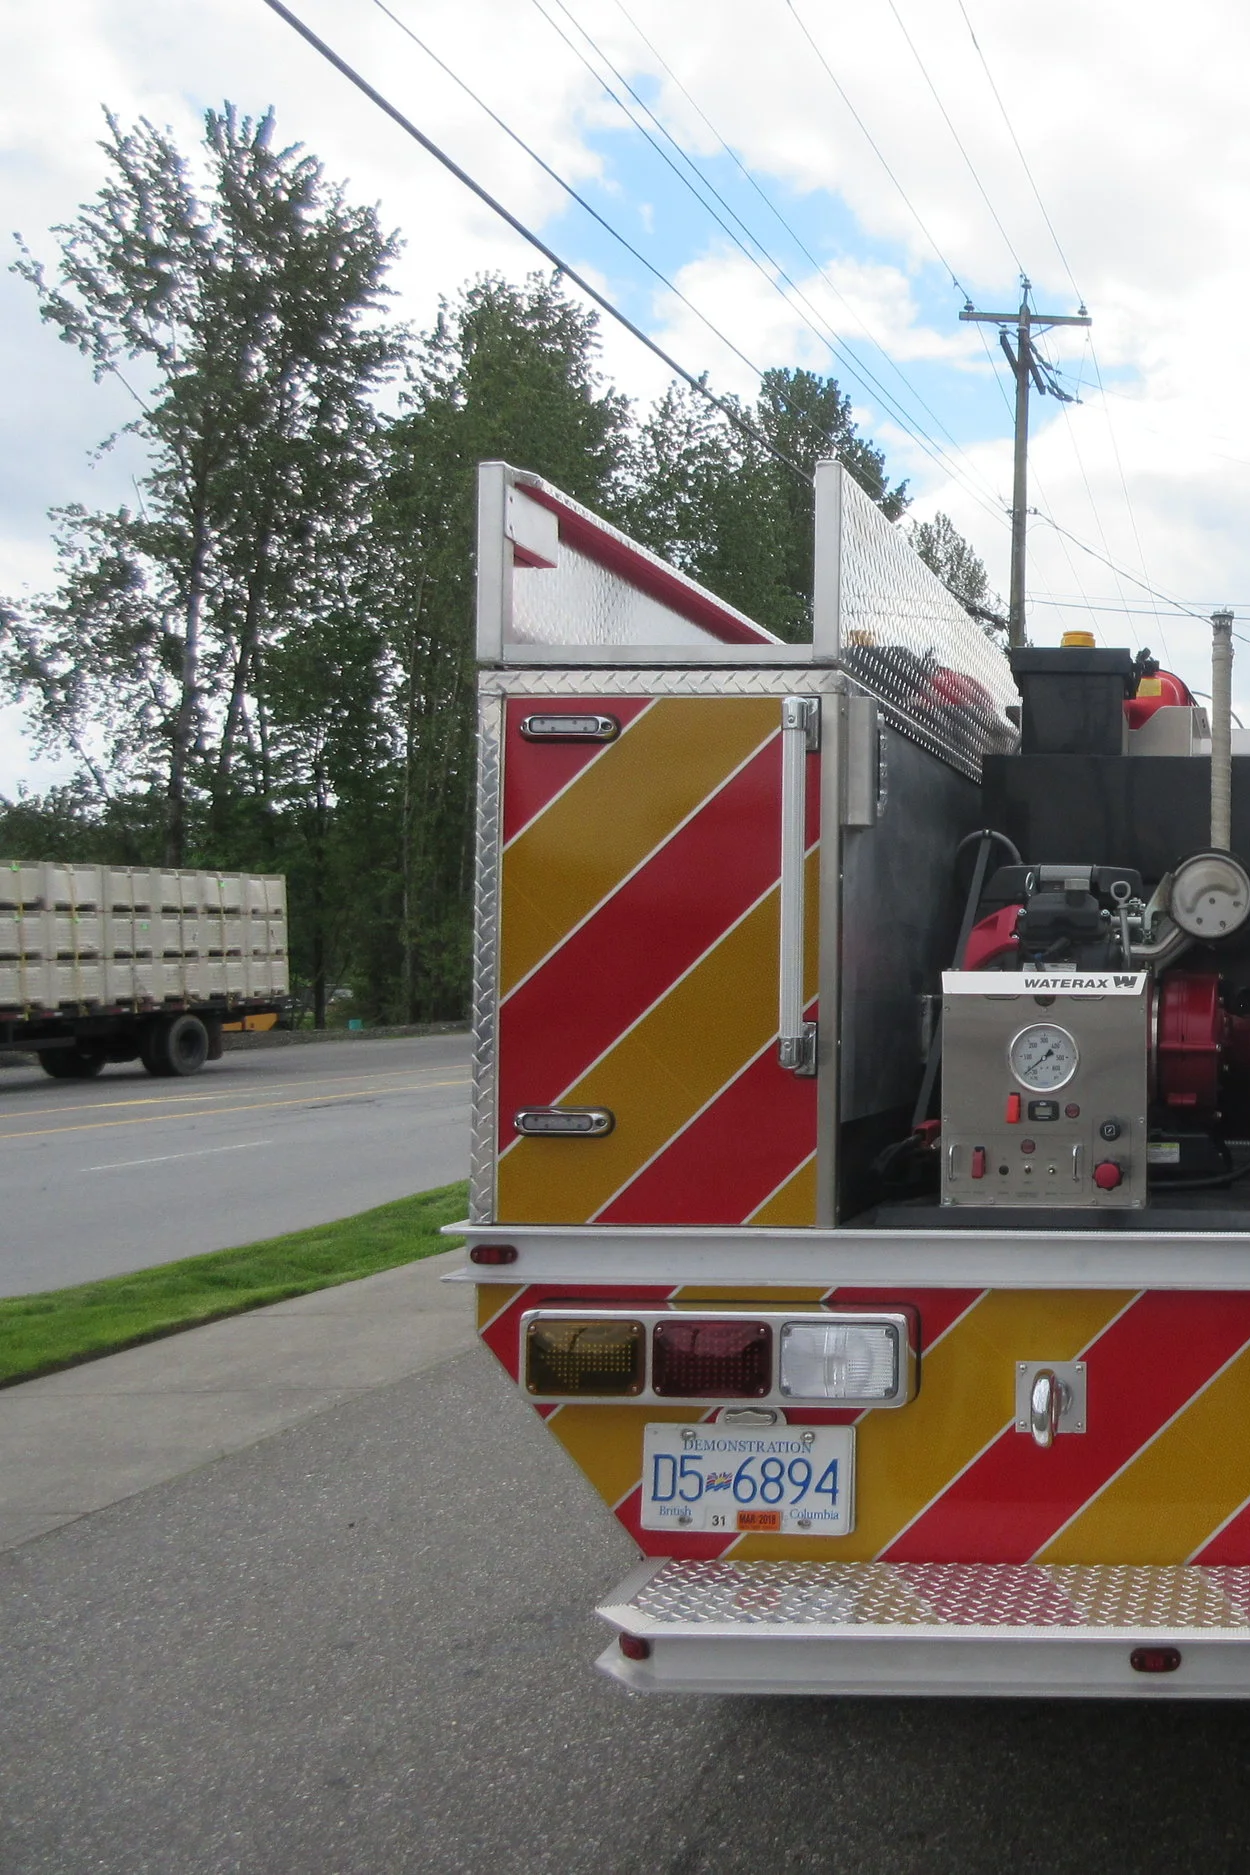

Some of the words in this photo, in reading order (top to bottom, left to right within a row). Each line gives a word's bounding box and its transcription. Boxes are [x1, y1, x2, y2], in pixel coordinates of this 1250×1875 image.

[1024, 979, 1109, 989] WATERAX
[683, 1438, 812, 1454] DEMONSTRATION
[651, 1454, 704, 1502] D5
[732, 1456, 839, 1505] 6894
[659, 1505, 692, 1517] British
[789, 1508, 840, 1520] Columbia
[712, 1515, 726, 1526] 31
[739, 1514, 756, 1524] MAR
